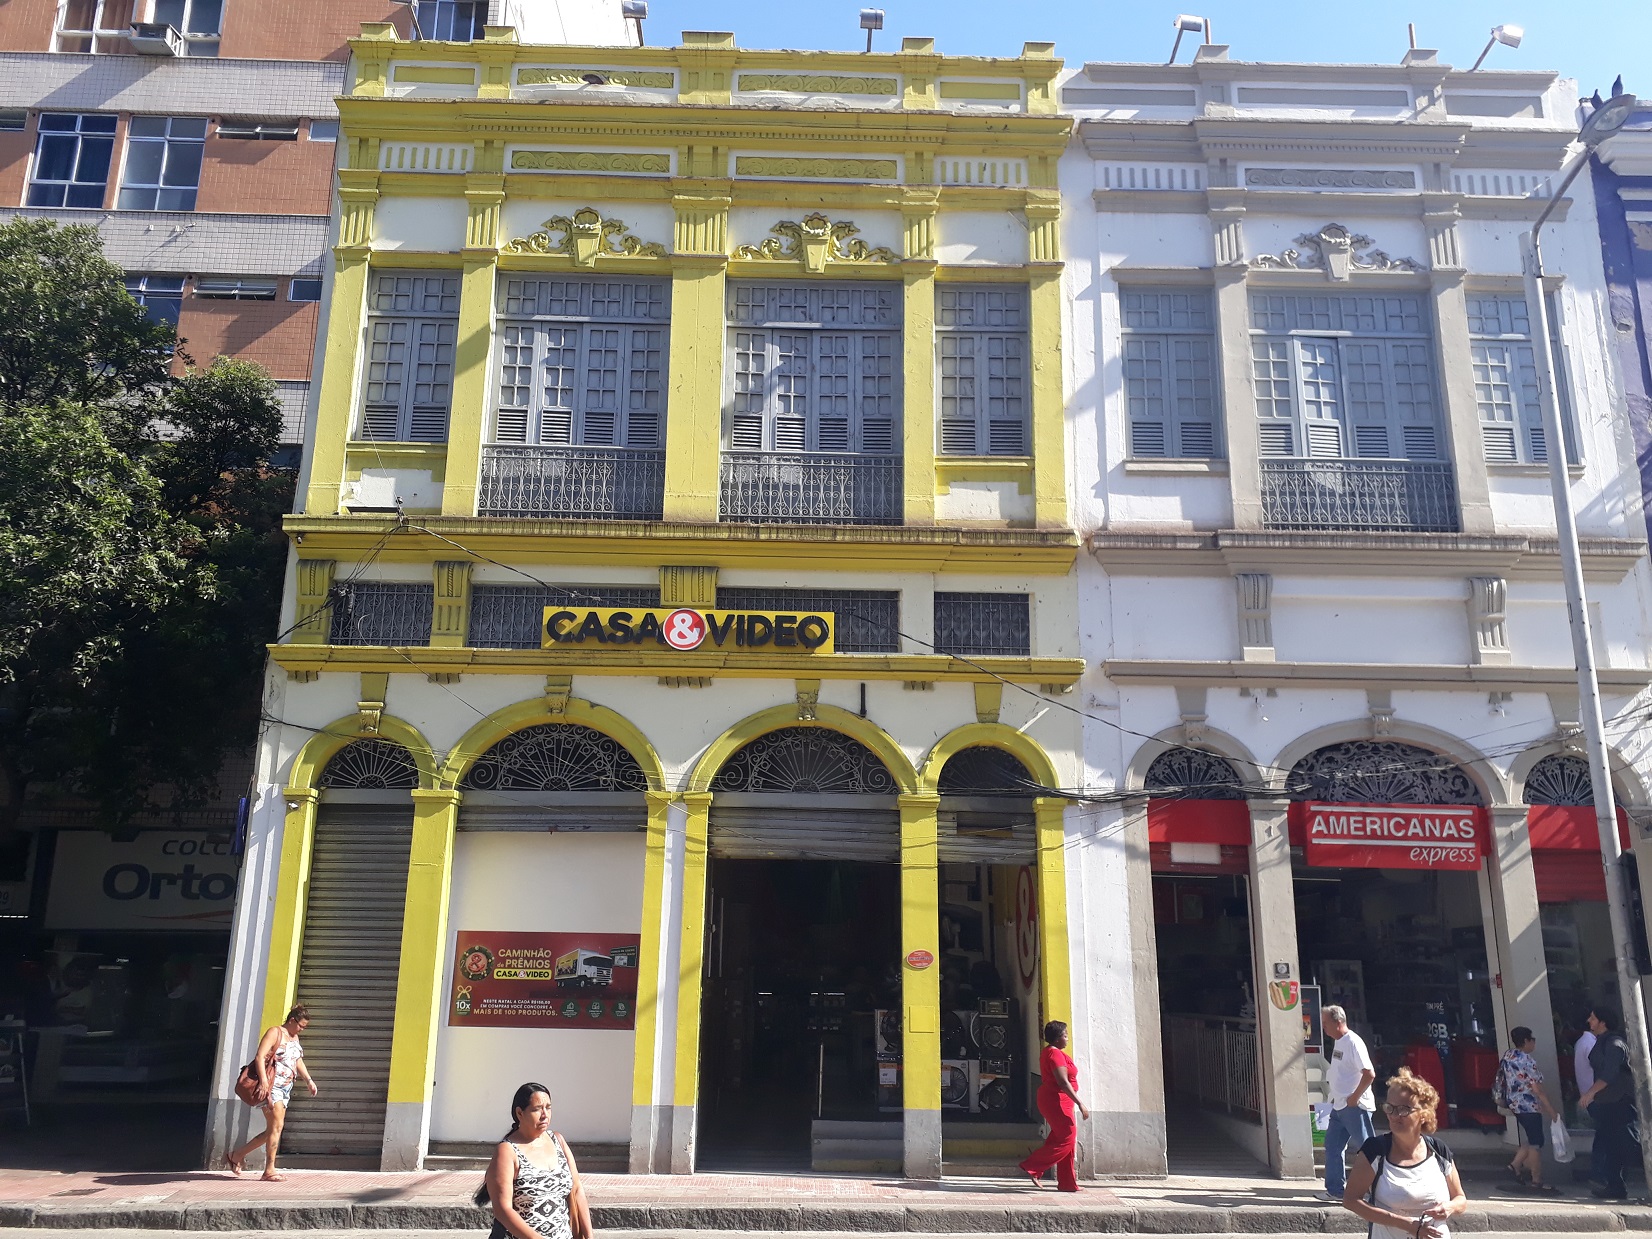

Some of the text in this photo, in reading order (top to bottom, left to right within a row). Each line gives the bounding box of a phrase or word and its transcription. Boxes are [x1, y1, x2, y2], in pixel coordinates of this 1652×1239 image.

[546, 610, 829, 649] CASA&VIDEO
[1311, 815, 1475, 838] AMERICANAS
[162, 839, 238, 856] COLC
[1409, 846, 1476, 866] express
[498, 947, 552, 959] CAMINHÃO
[505, 958, 551, 969] PRÊMIOS
[496, 970, 550, 979] CASA&VIDEO
[456, 1001, 471, 1010] 10x
